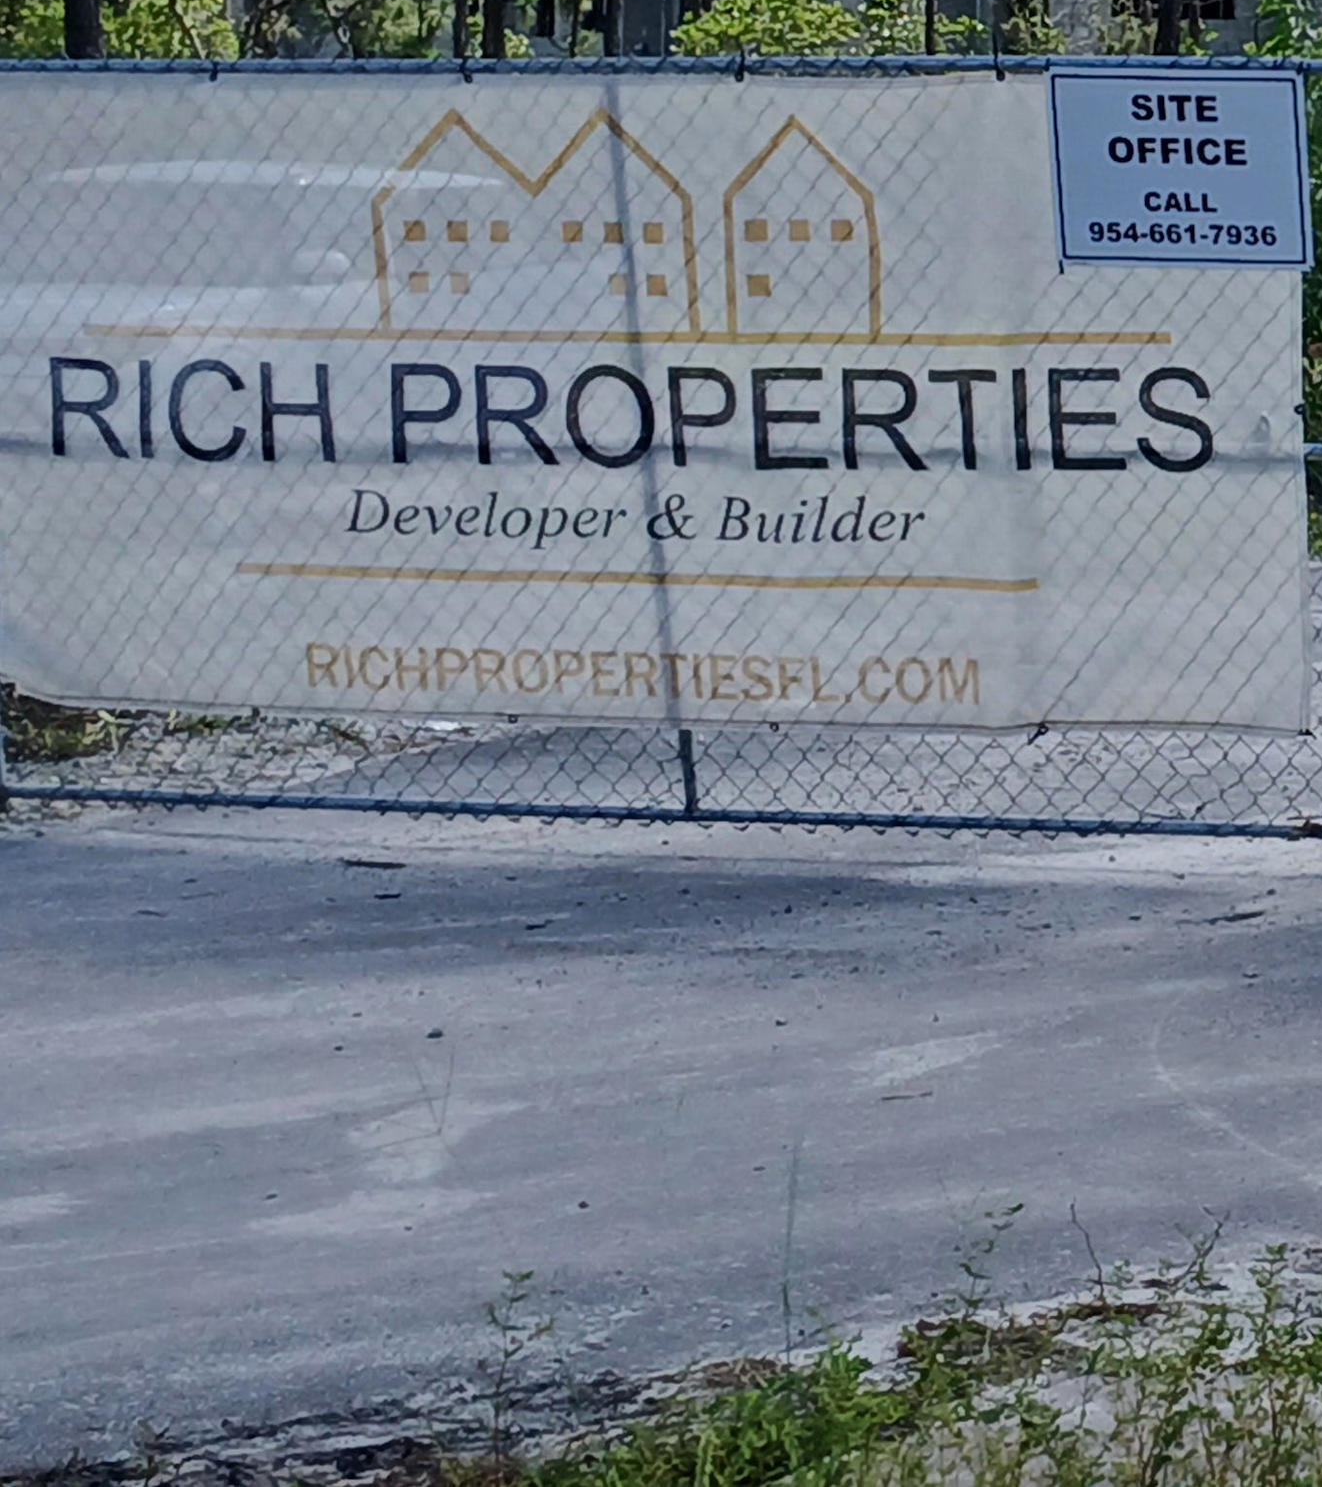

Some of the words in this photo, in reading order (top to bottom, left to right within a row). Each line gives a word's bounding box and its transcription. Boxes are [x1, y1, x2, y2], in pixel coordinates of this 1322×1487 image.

[1131, 94, 1219, 123] SITE
[1108, 136, 1248, 166] OFFICE
[1143, 191, 1218, 214] CALL
[1088, 221, 1278, 247] 954-661-7936
[49, 356, 337, 463] RICH
[390, 363, 1215, 473] PROPERTIES
[346, 488, 629, 550] Developer
[646, 492, 698, 540] &
[716, 495, 927, 545] Builder
[304, 640, 981, 706] RICHPROPERTIESFL.COM
